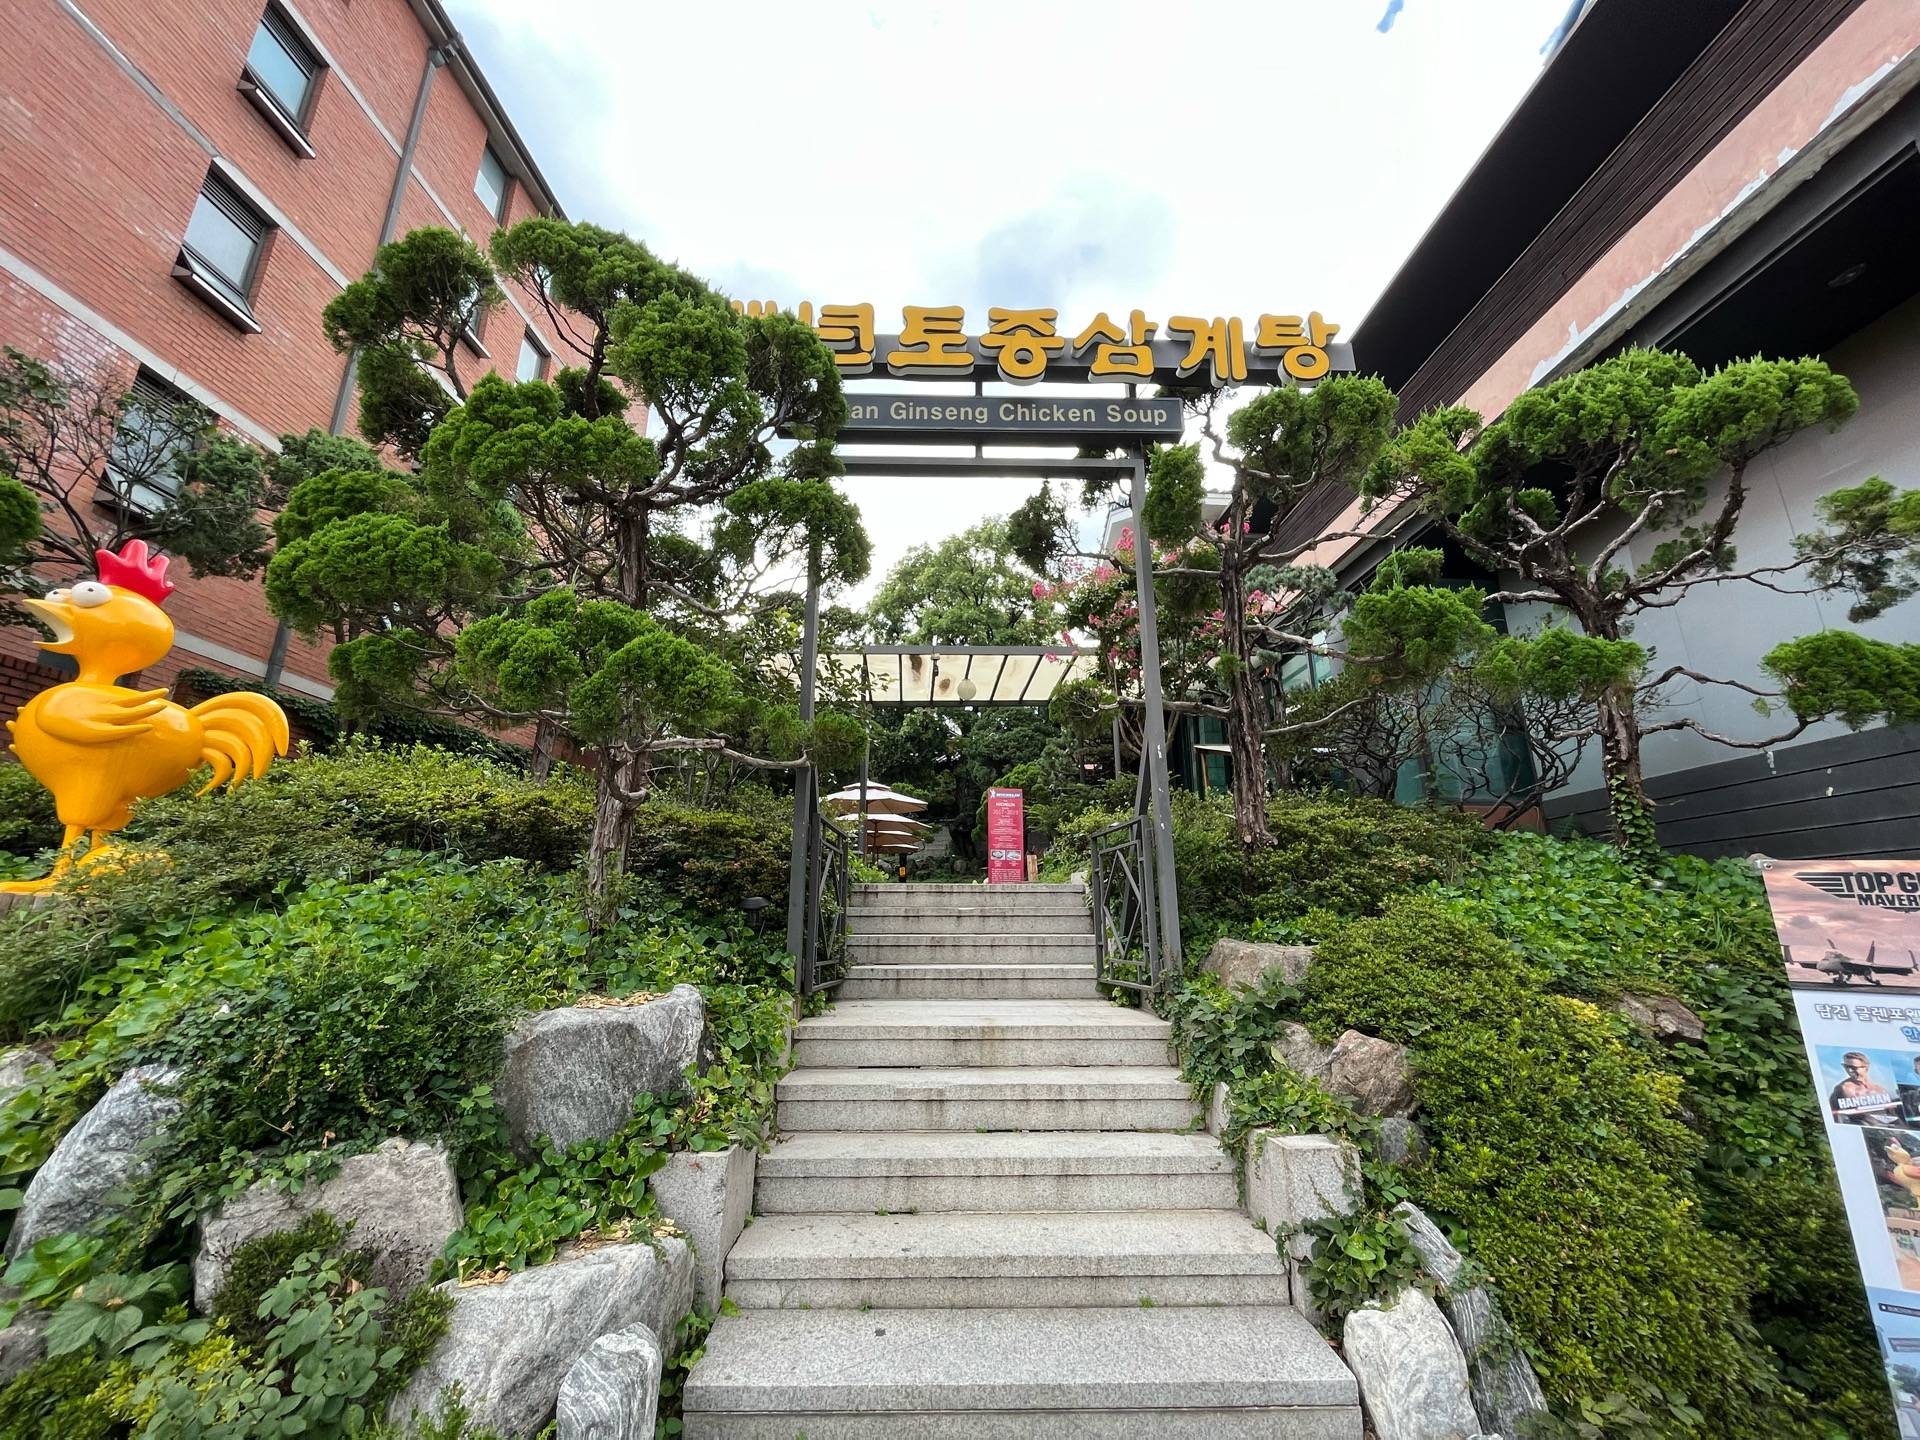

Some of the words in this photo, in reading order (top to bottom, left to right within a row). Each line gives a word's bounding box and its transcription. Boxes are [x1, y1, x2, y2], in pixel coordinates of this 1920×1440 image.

[731, 300, 1341, 382] 년토종삼계탕
[890, 402, 989, 424] Ginseng
[999, 402, 1096, 422] Chicken
[1106, 405, 1168, 425] Soup
[1842, 872, 1895, 894] TOP
[1856, 893, 1920, 907] MAVER
[1837, 1093, 1891, 1109] HANGMAN
